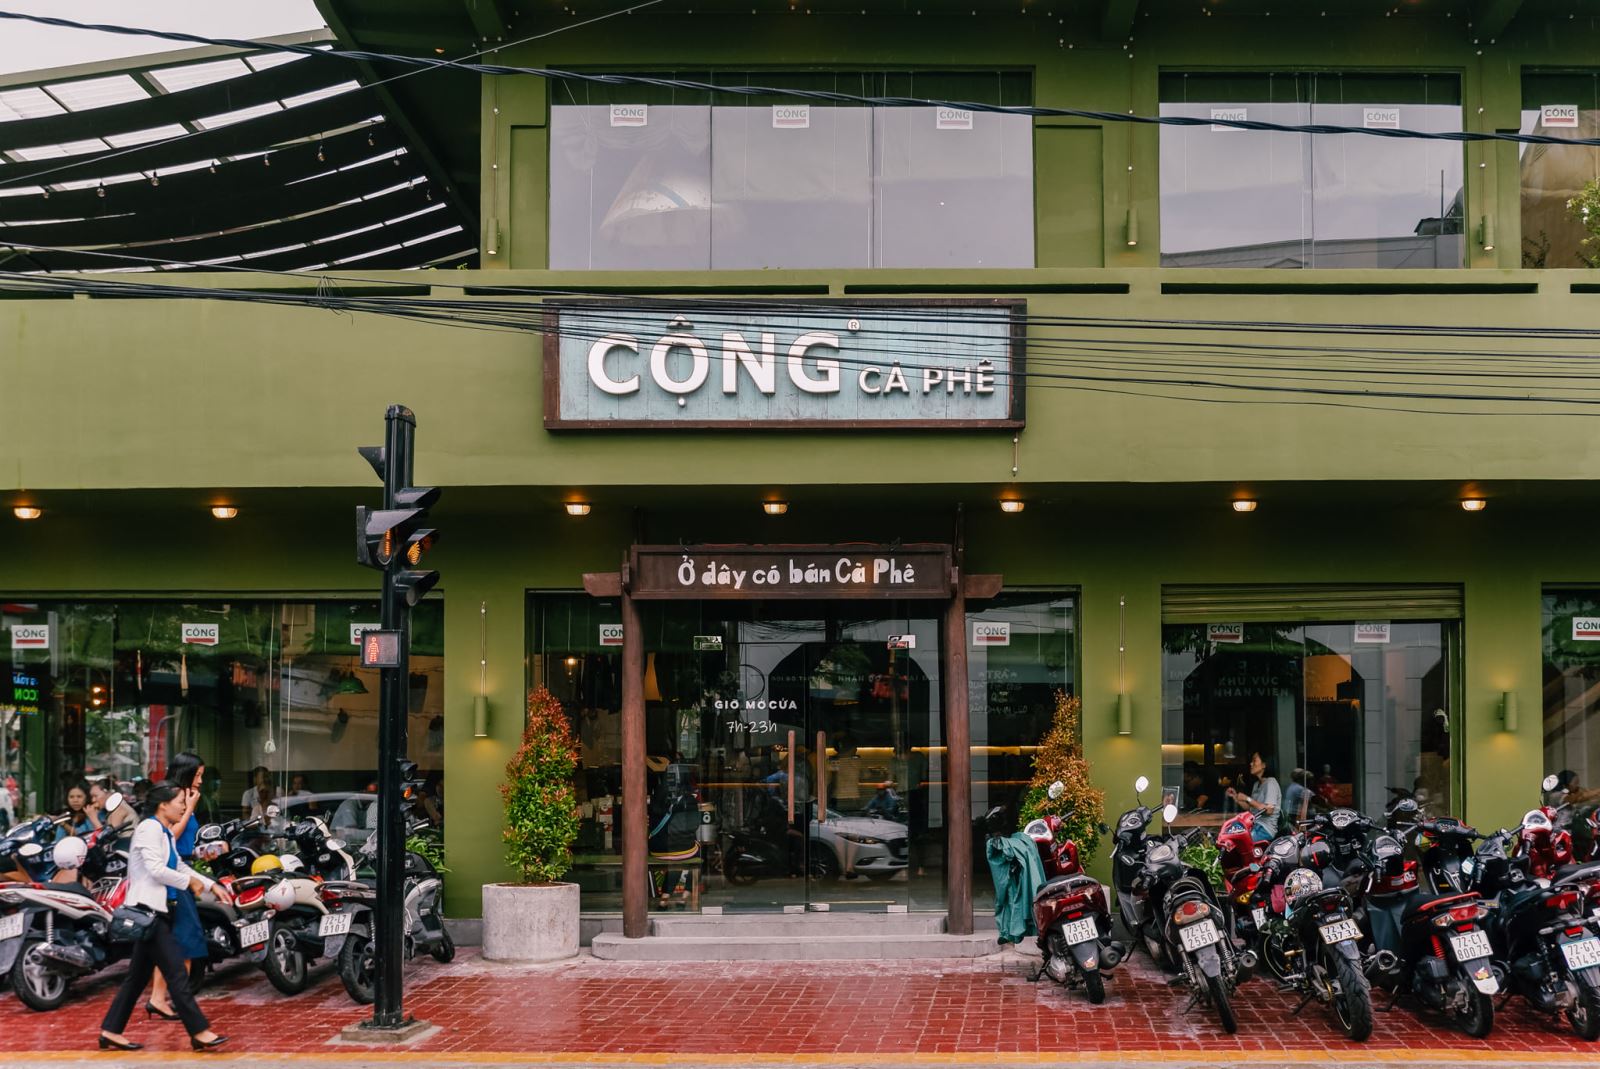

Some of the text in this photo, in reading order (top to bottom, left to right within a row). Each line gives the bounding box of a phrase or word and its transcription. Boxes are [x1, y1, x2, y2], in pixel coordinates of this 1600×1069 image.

[588, 315, 841, 407] CỘNG
[923, 358, 994, 394] PHÊ
[677, 555, 915, 590] Ở đây có bán Cà Phê
[726, 720, 777, 734] 7h-23h
[1188, 932, 1214, 949] 2550
